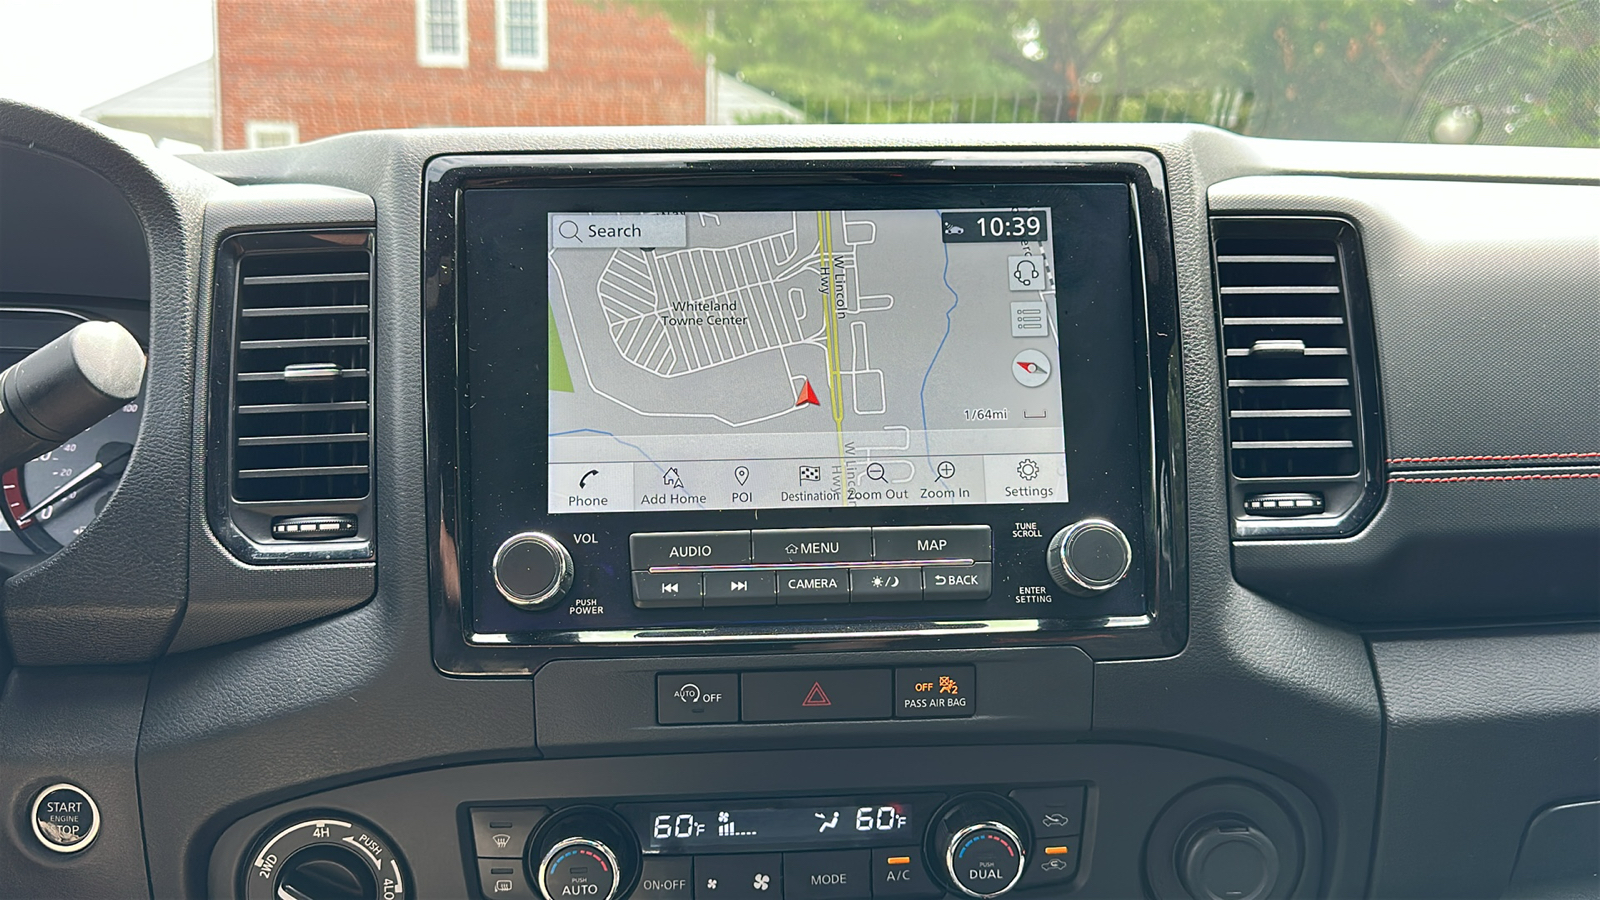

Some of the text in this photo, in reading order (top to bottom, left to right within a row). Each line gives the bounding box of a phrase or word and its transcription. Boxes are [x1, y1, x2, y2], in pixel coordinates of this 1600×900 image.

[588, 224, 642, 238] Search
[976, 216, 1041, 237] 10:39
[818, 267, 830, 295] Hwy
[834, 255, 848, 320] W Lincoln
[673, 300, 737, 313] Whiteland
[662, 315, 748, 327] Towne Center
[964, 408, 1008, 421] 1/64mi
[60, 468, 73, 477] 20
[732, 492, 753, 503] POI
[781, 490, 840, 502] Destination
[847, 488, 909, 500] Zoom Out
[920, 487, 970, 499] Zoom In
[1005, 486, 1054, 498] Settings
[569, 495, 609, 506] Phone
[641, 493, 707, 505] Add Home
[41, 505, 53, 519] 0
[1014, 523, 1037, 531] TUNE
[573, 533, 599, 544] VOL
[1012, 530, 1043, 538] SCROLL
[800, 541, 840, 554] MENU
[917, 539, 947, 551] MAP
[669, 545, 712, 558] AUDIO
[788, 578, 838, 590] CAMERA
[948, 575, 979, 587] BACK
[1019, 586, 1047, 595] ENTER
[575, 598, 597, 606] PUSH
[1015, 594, 1052, 604] SETTING
[569, 605, 604, 615] POWER
[915, 682, 934, 692] OFF
[673, 690, 723, 703] AUTO OFF
[904, 697, 967, 709] PASS AIR BAG
[46, 801, 83, 813] START
[50, 815, 79, 823] ENGINE
[50, 825, 80, 836] TOP
[312, 827, 331, 838] 4H
[358, 834, 382, 855] PUSH
[259, 854, 278, 879] 2WD
[810, 874, 847, 886] MODE
[886, 870, 911, 882] A/C
[969, 869, 1004, 880] DUAL
[383, 878, 396, 900] 4LO
[562, 884, 598, 896] AUTO
